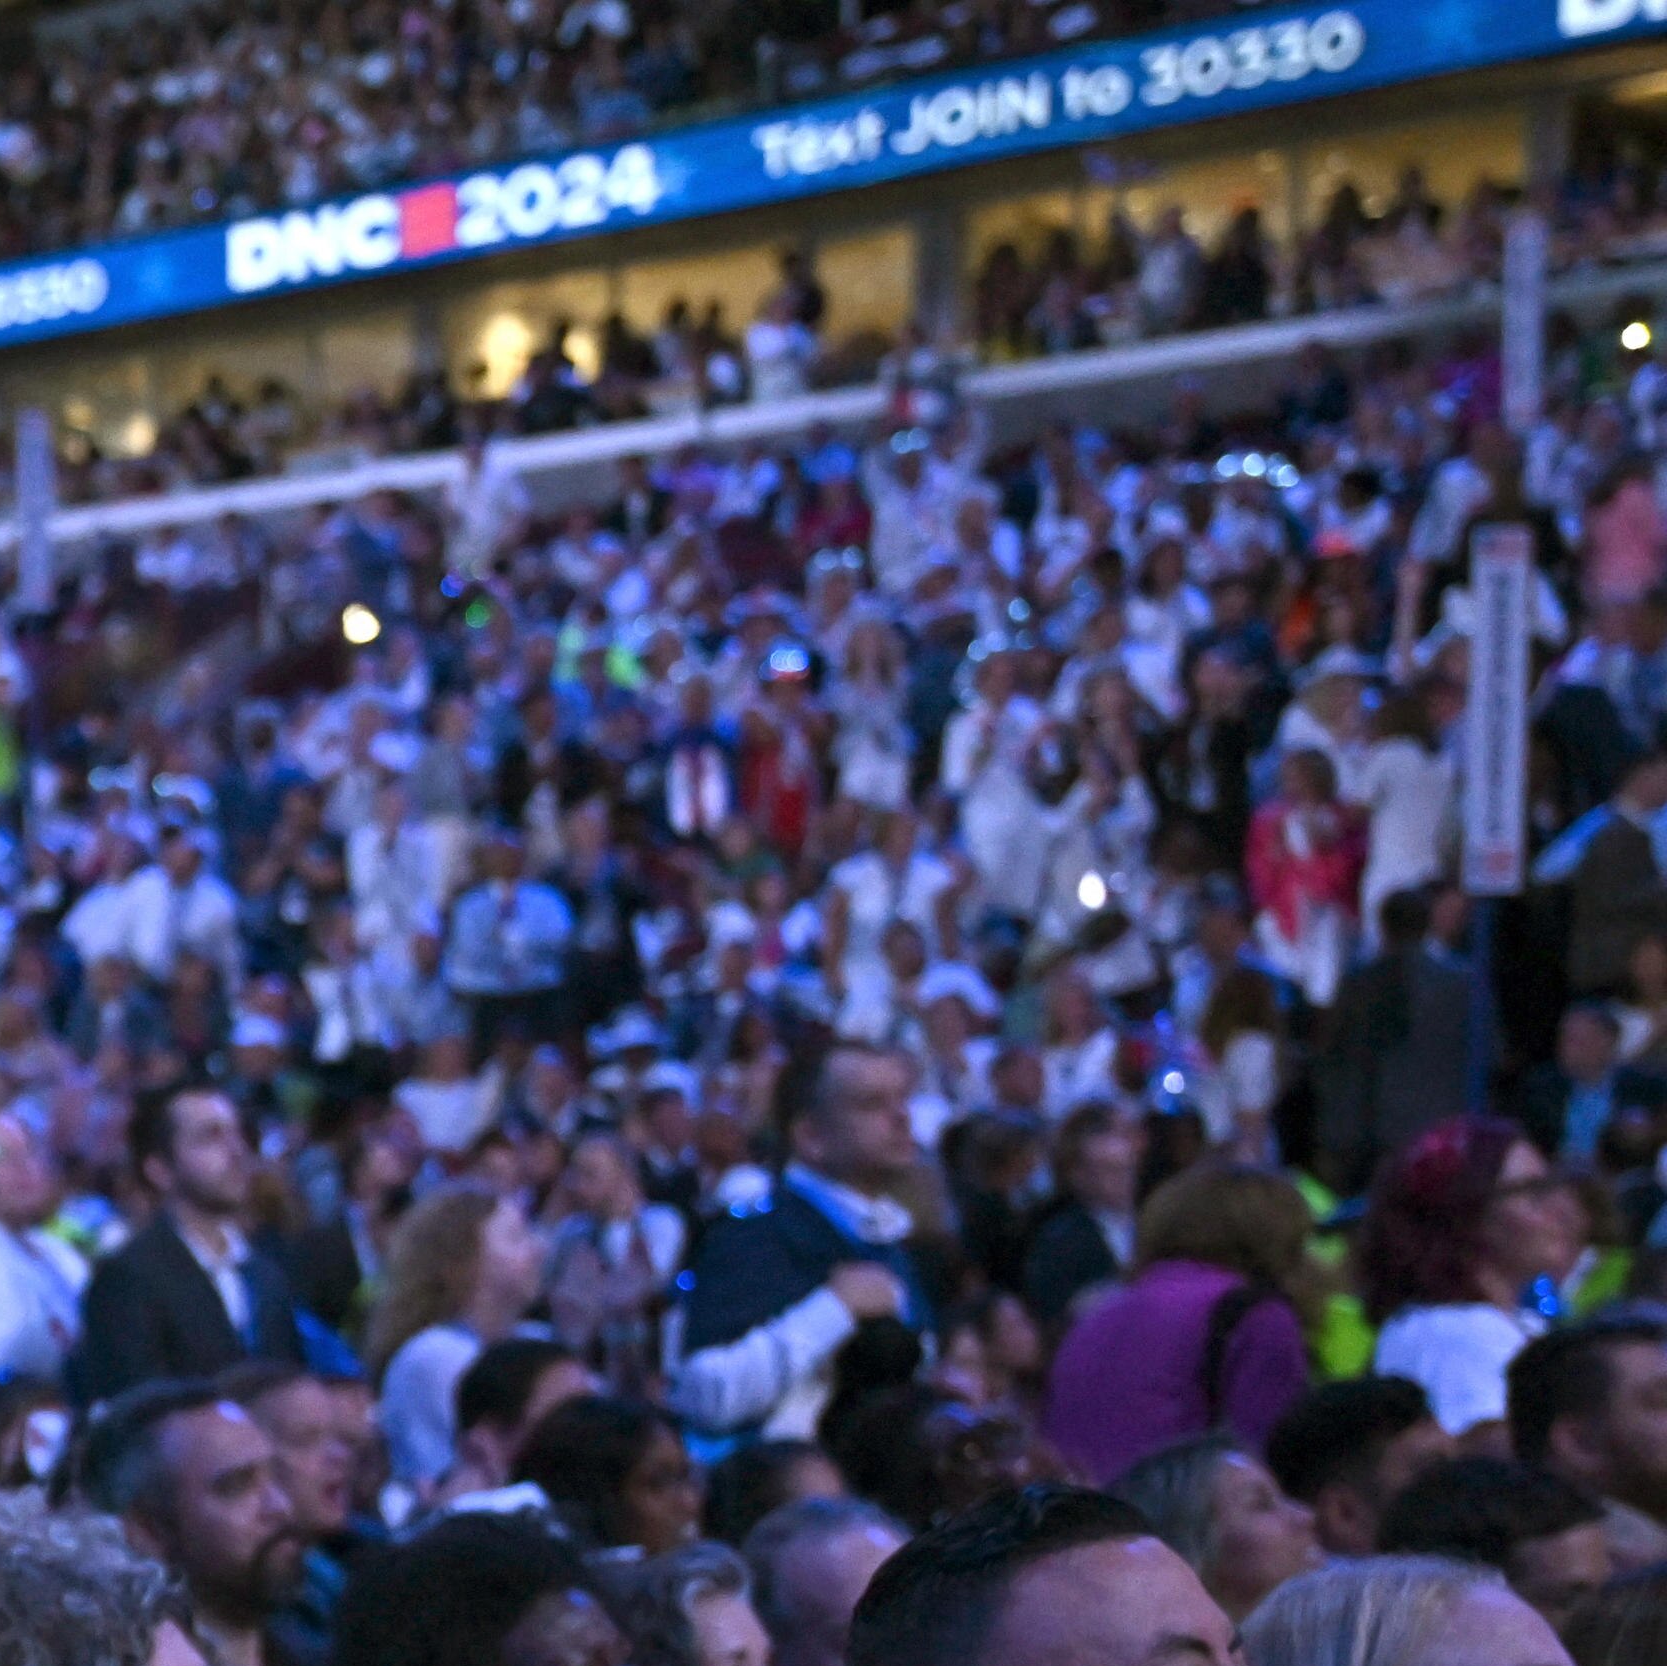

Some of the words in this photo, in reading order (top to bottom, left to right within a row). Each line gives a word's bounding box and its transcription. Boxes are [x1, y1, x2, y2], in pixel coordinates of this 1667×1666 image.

[890, 71, 1054, 156] JOIN
[1139, 9, 1365, 107] 30330
[225, 192, 402, 293] DNC
[454, 143, 658, 249] 2024
